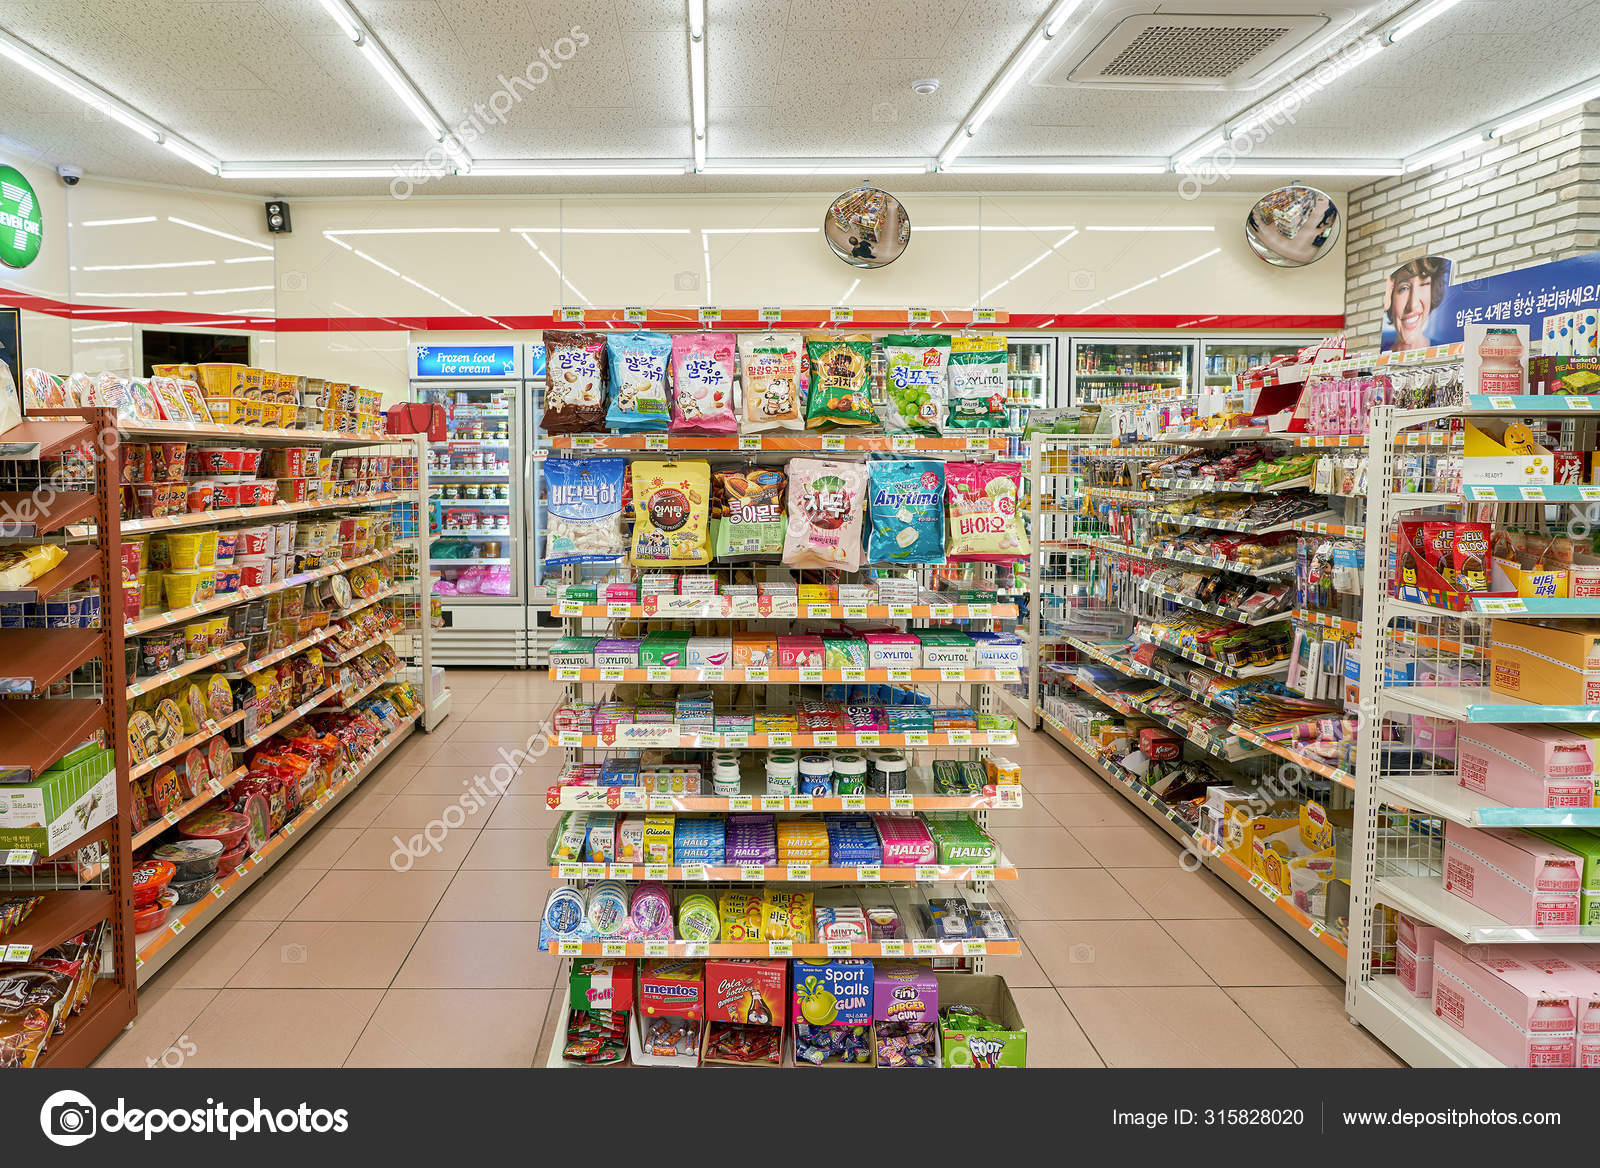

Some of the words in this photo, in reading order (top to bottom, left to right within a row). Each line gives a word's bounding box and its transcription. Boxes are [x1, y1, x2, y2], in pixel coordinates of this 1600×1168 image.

[0, 211, 24, 230] EVEN
[1455, 306, 1483, 328] 입술도
[1484, 301, 1512, 322] 4계절
[1513, 294, 1535, 317] 항상
[1536, 284, 1600, 312] 관리하세요!
[437, 352, 470, 364] Frozen
[473, 352, 496, 364] food
[558, 351, 590, 369] 말랑
[625, 356, 657, 372] 말랑
[440, 364, 457, 374] Ice
[459, 365, 491, 374] cream
[576, 363, 595, 377] 카우
[642, 366, 664, 382] 카우
[686, 360, 716, 378] 말랑
[1554, 364, 1575, 372] REAL
[701, 370, 723, 384] 카우
[891, 366, 939, 388] 청포도
[965, 375, 1004, 386] XYLITOL
[552, 484, 618, 507] 비단박하
[874, 490, 940, 509] Anytime
[654, 504, 683, 518] 알사탕
[729, 500, 782, 524] 통아몬드
[960, 515, 1006, 535] 바이오
[1461, 530, 1483, 542] JELLY
[1457, 540, 1488, 553] BLOCK
[1532, 574, 1554, 586] 비타
[1534, 584, 1557, 597] 파워
[560, 657, 590, 665] XYLITOL
[604, 657, 633, 665] XYLITOL
[882, 651, 914, 659] XYLITOL
[937, 653, 969, 662] XYLITOL
[645, 827, 671, 836] Ricola
[682, 839, 709, 847] HALLS
[786, 839, 814, 847] HALLS
[682, 849, 709, 857] HALLS
[734, 848, 760, 856] HALLS
[786, 849, 814, 857] HALLS
[888, 844, 930, 857] HALLS
[949, 846, 992, 859] HALLS
[830, 928, 859, 937] MINTY
[825, 968, 864, 982] Sport
[644, 984, 698, 997] mentos
[717, 978, 742, 994] Cola
[726, 985, 754, 997] bottles
[834, 982, 869, 995] balls
[586, 987, 615, 1003] Trolli
[834, 997, 866, 1010] GUM
[887, 1001, 926, 1015] BURGER
[897, 1011, 917, 1021] GUM
